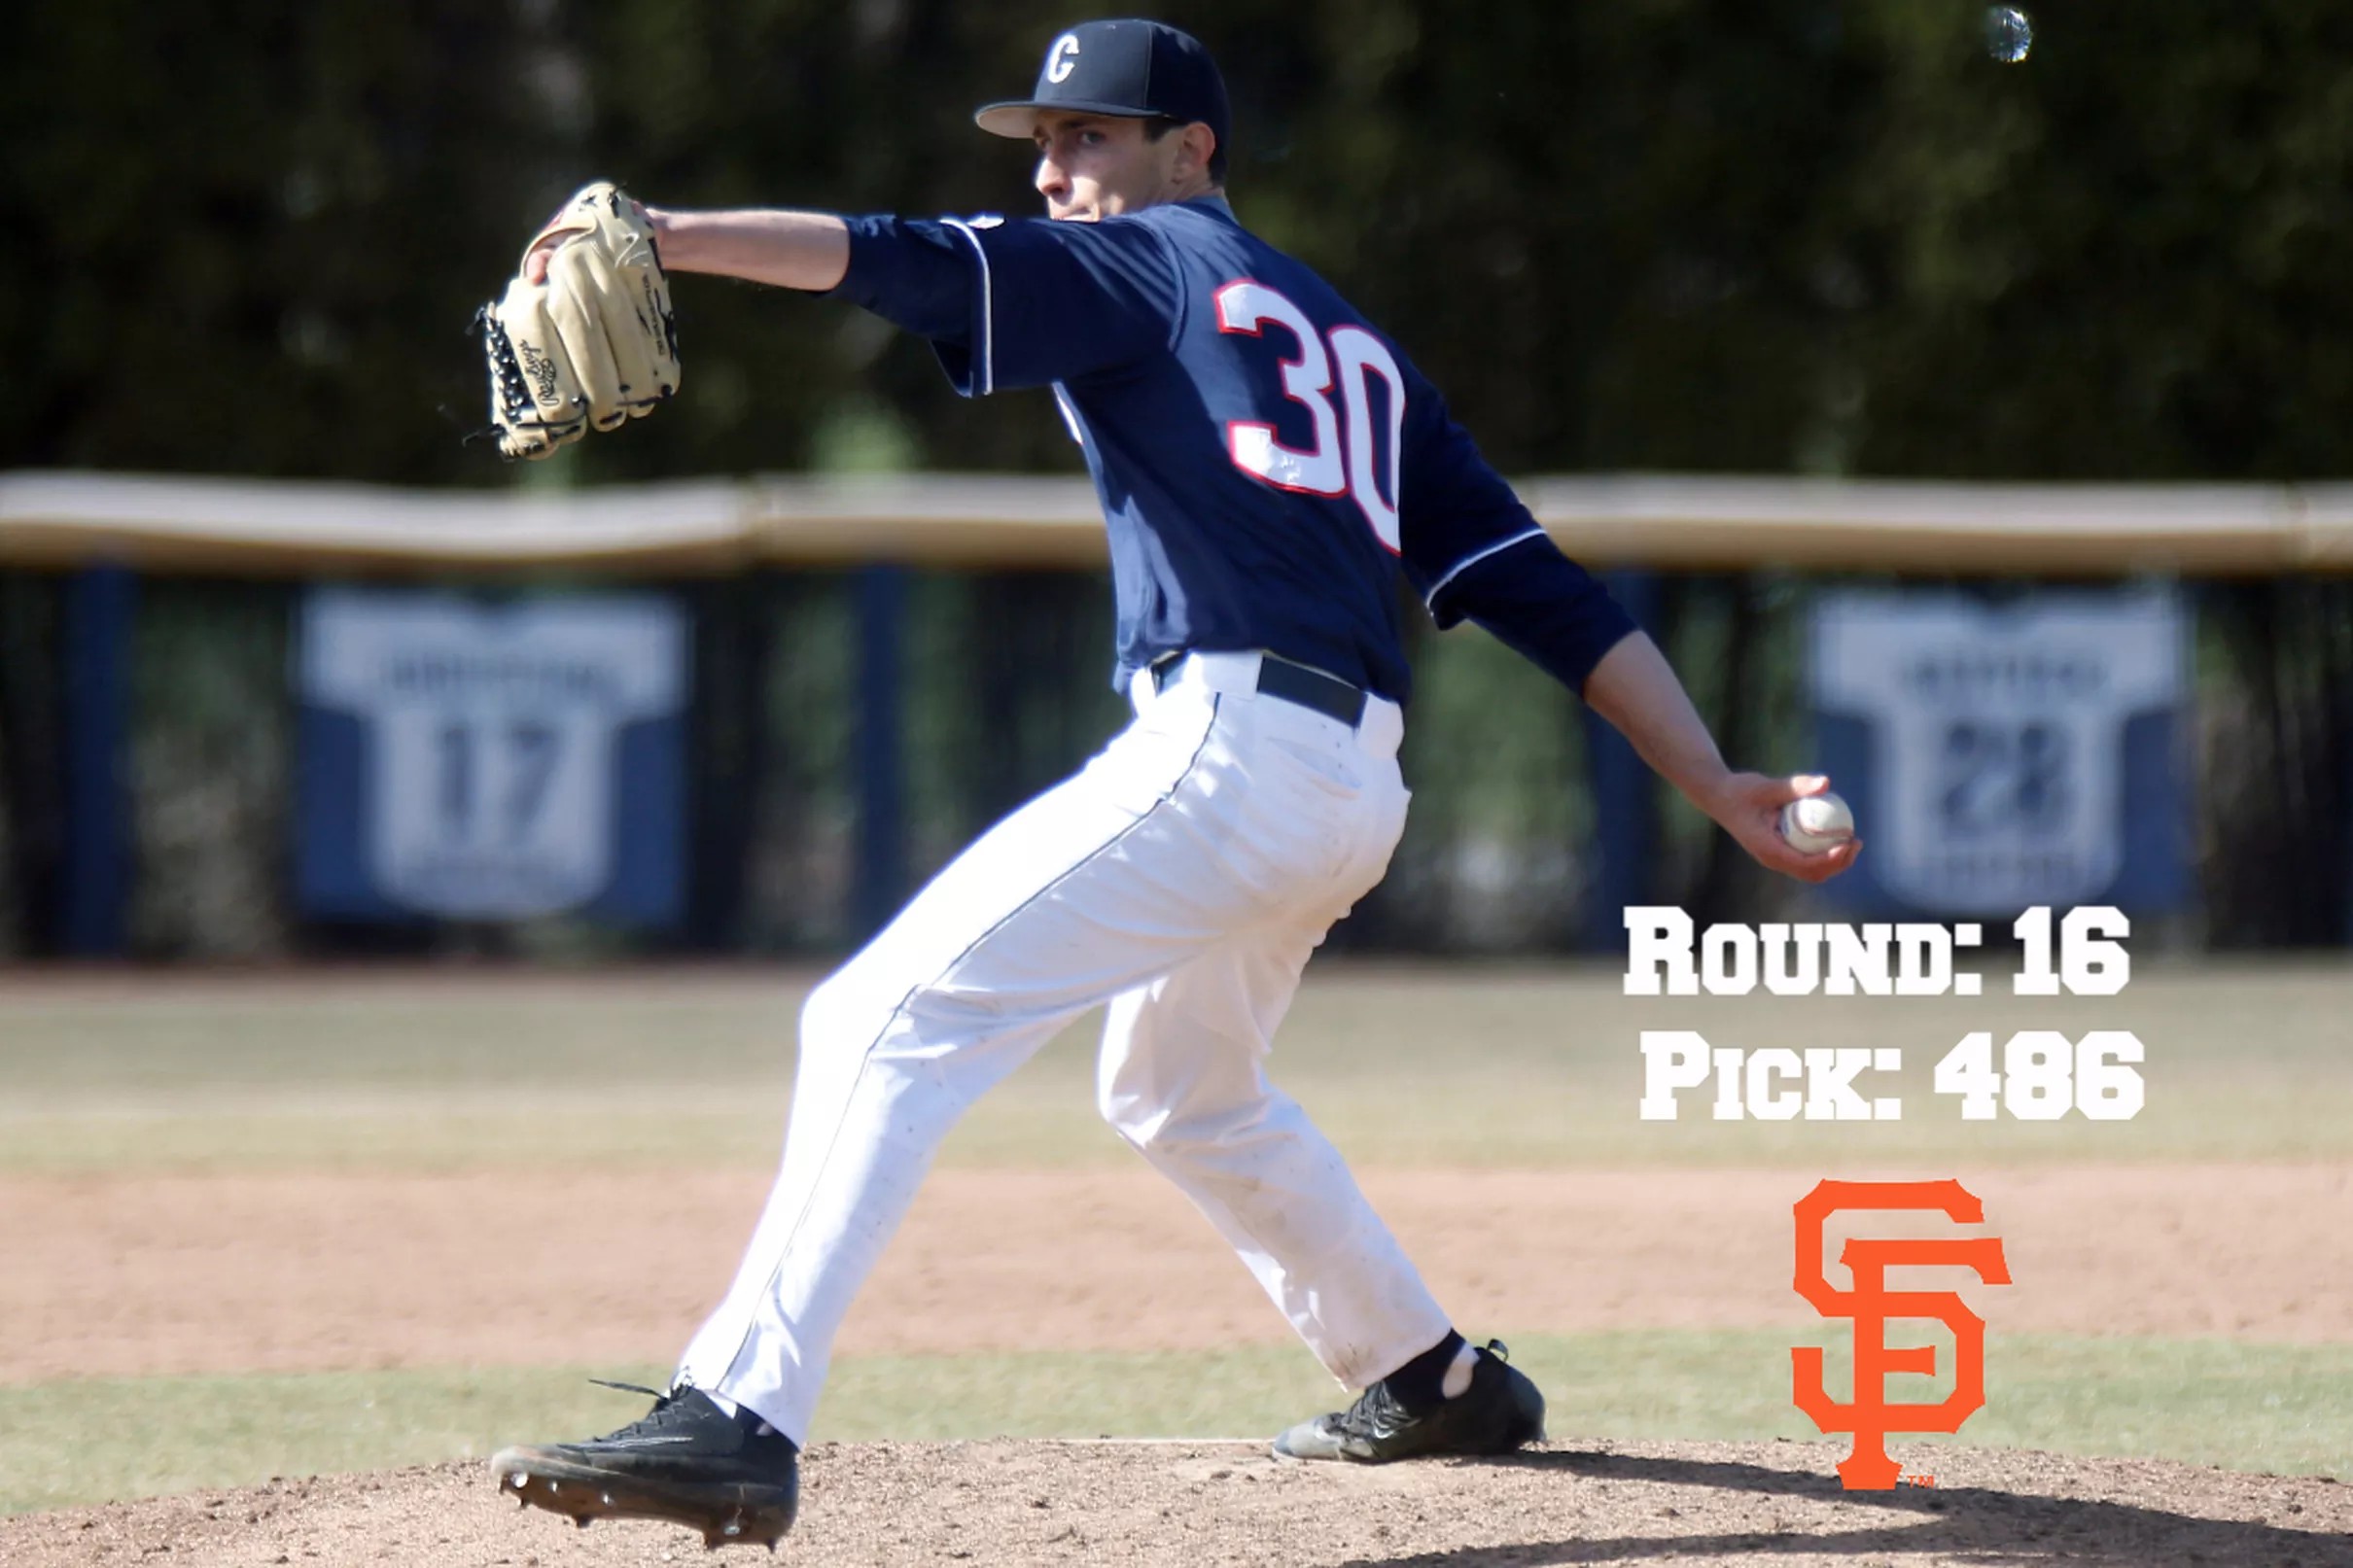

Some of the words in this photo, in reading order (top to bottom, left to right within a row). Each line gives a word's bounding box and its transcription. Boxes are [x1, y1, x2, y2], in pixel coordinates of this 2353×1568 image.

[1046, 34, 1080, 84] C
[1213, 278, 1406, 557] 30
[439, 719, 563, 844] 17
